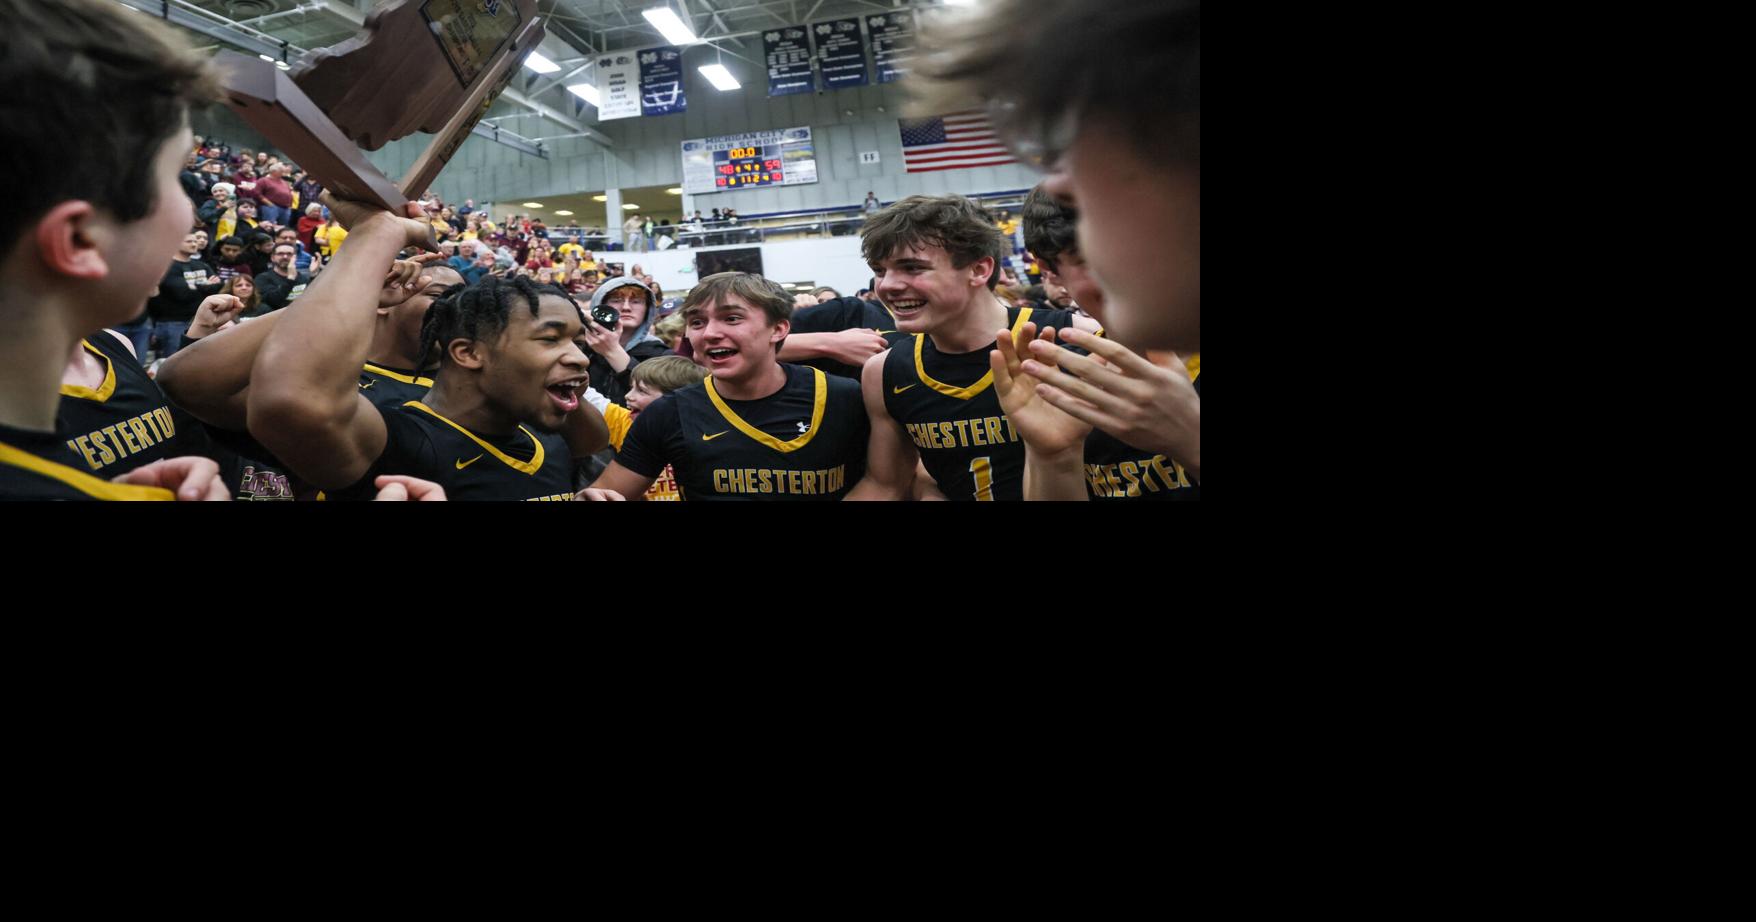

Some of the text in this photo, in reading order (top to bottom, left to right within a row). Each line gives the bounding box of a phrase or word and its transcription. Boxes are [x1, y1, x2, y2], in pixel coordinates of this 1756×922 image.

[705, 129, 785, 144] MICHIGAN CITY
[705, 142, 733, 151] HIGH
[719, 165, 734, 174] 48
[764, 160, 780, 170] 59
[67, 406, 175, 470] ESTERTO
[713, 464, 845, 494] CHESTERTON
[969, 457, 994, 501] 1
